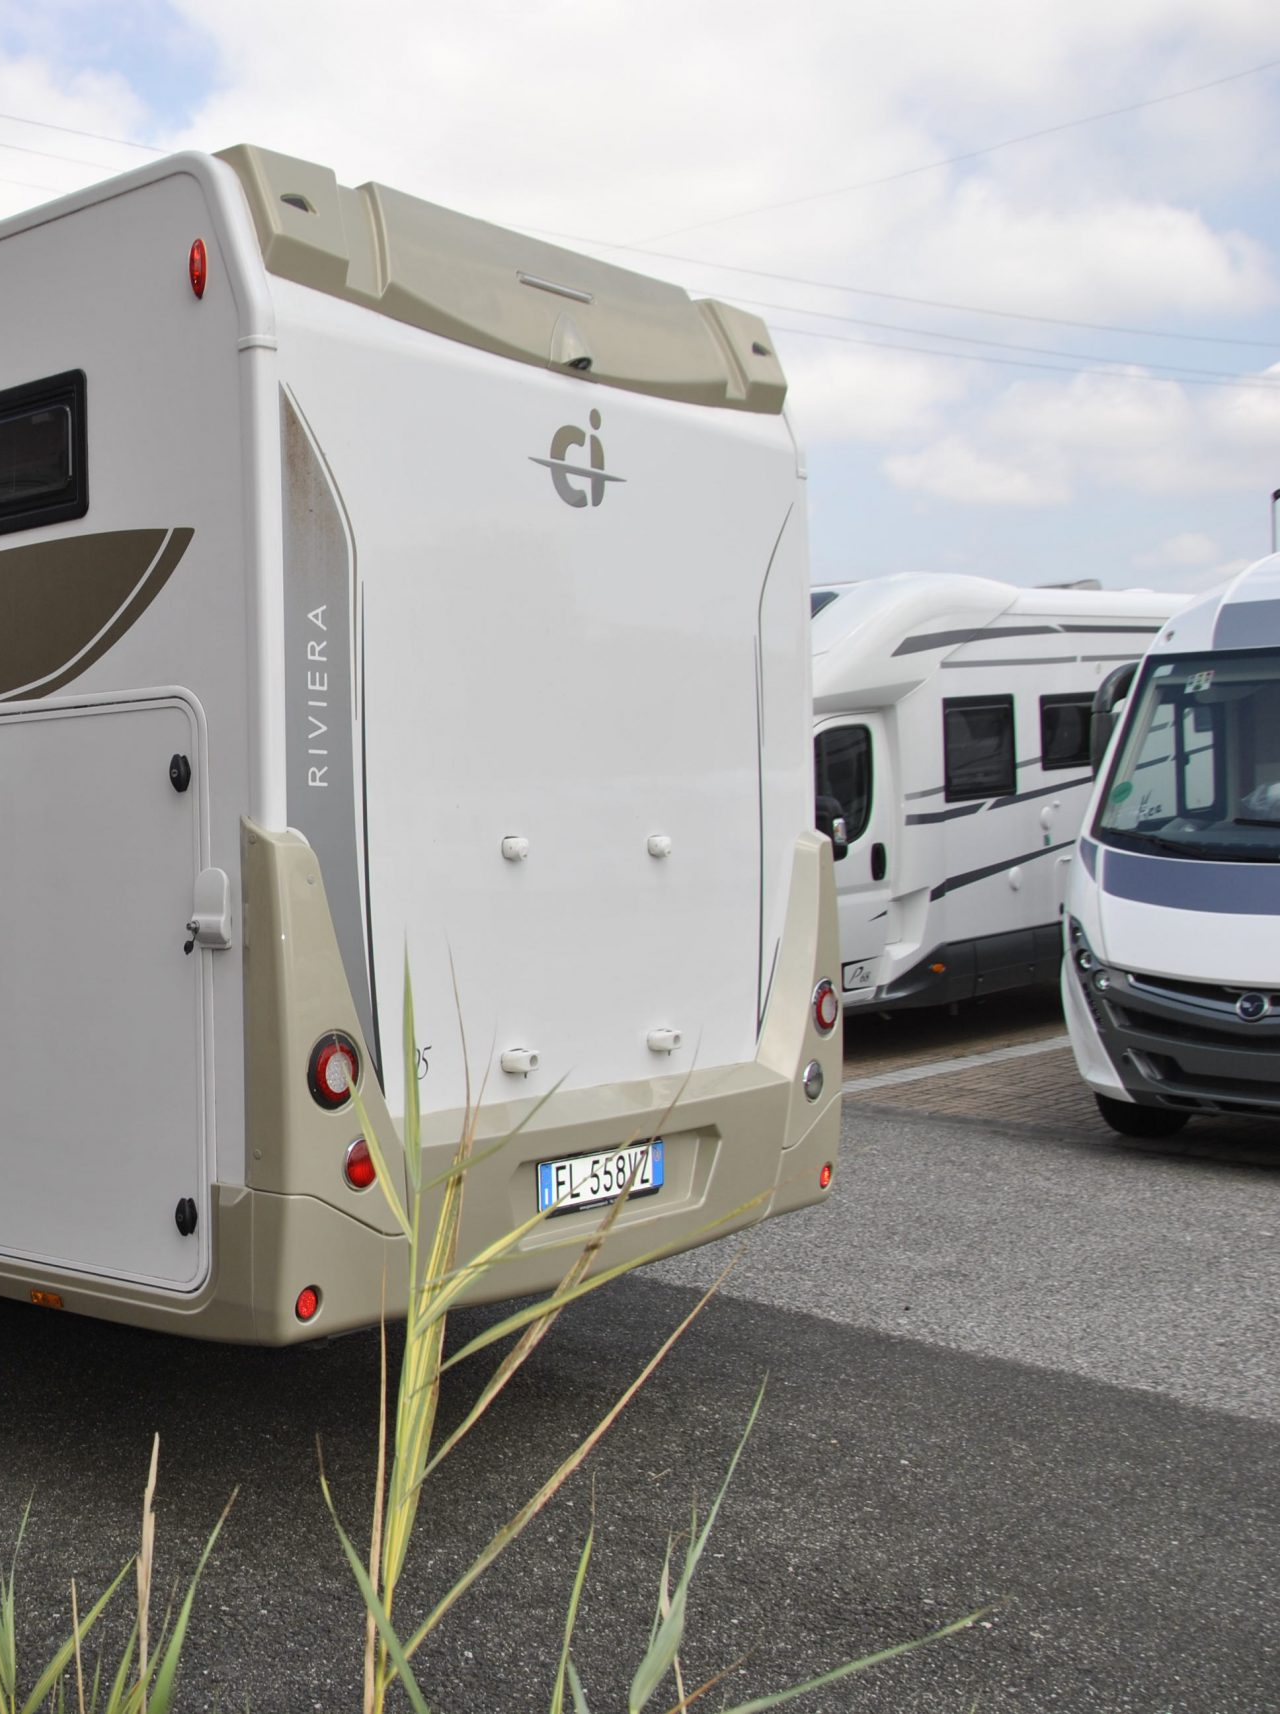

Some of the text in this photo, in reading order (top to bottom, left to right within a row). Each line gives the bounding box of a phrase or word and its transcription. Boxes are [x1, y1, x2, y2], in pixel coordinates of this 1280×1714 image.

[307, 604, 329, 787] RIVIERA
[556, 1164, 580, 1204] FL
[590, 1150, 650, 1195] 558VZ
